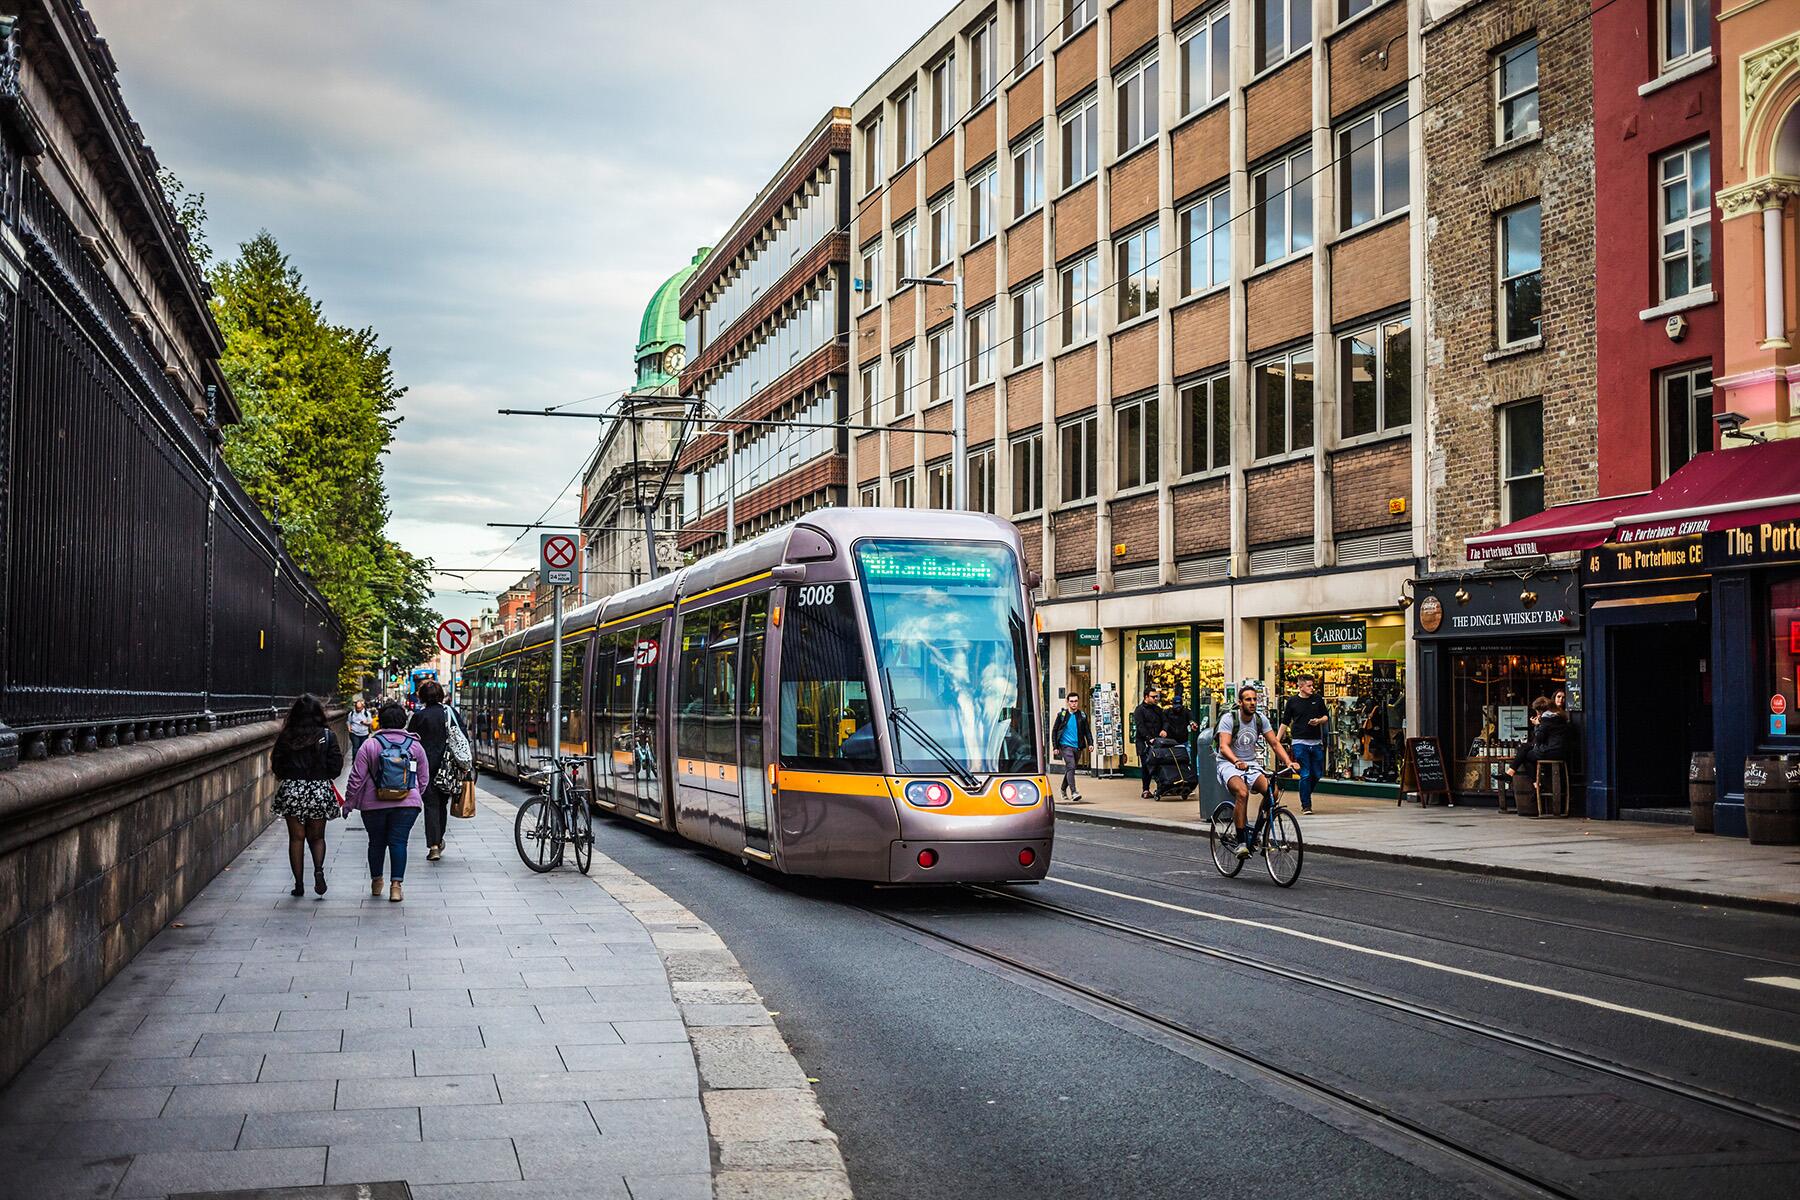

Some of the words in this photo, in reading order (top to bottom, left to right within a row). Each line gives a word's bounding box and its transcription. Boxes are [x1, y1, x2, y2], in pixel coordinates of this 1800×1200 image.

[1620, 530, 1633, 542] The
[1634, 526, 1676, 541] Porterhouse
[1678, 519, 1711, 535] CENTRAL
[1725, 527, 1753, 556] The
[1470, 548, 1481, 559] The
[1481, 546, 1513, 558] Porterhouse
[1513, 542, 1539, 555] CENTRAL
[1617, 552, 1632, 570] The
[1635, 548, 1686, 568] Porterhouse
[1689, 545, 1703, 563] CE
[1589, 556, 1600, 573] 45
[798, 584, 835, 607] 5008
[1452, 616, 1469, 627] THE
[1469, 613, 1502, 627] DINGLE
[1503, 610, 1544, 625] WHISKEY
[1544, 609, 1564, 623] BAR
